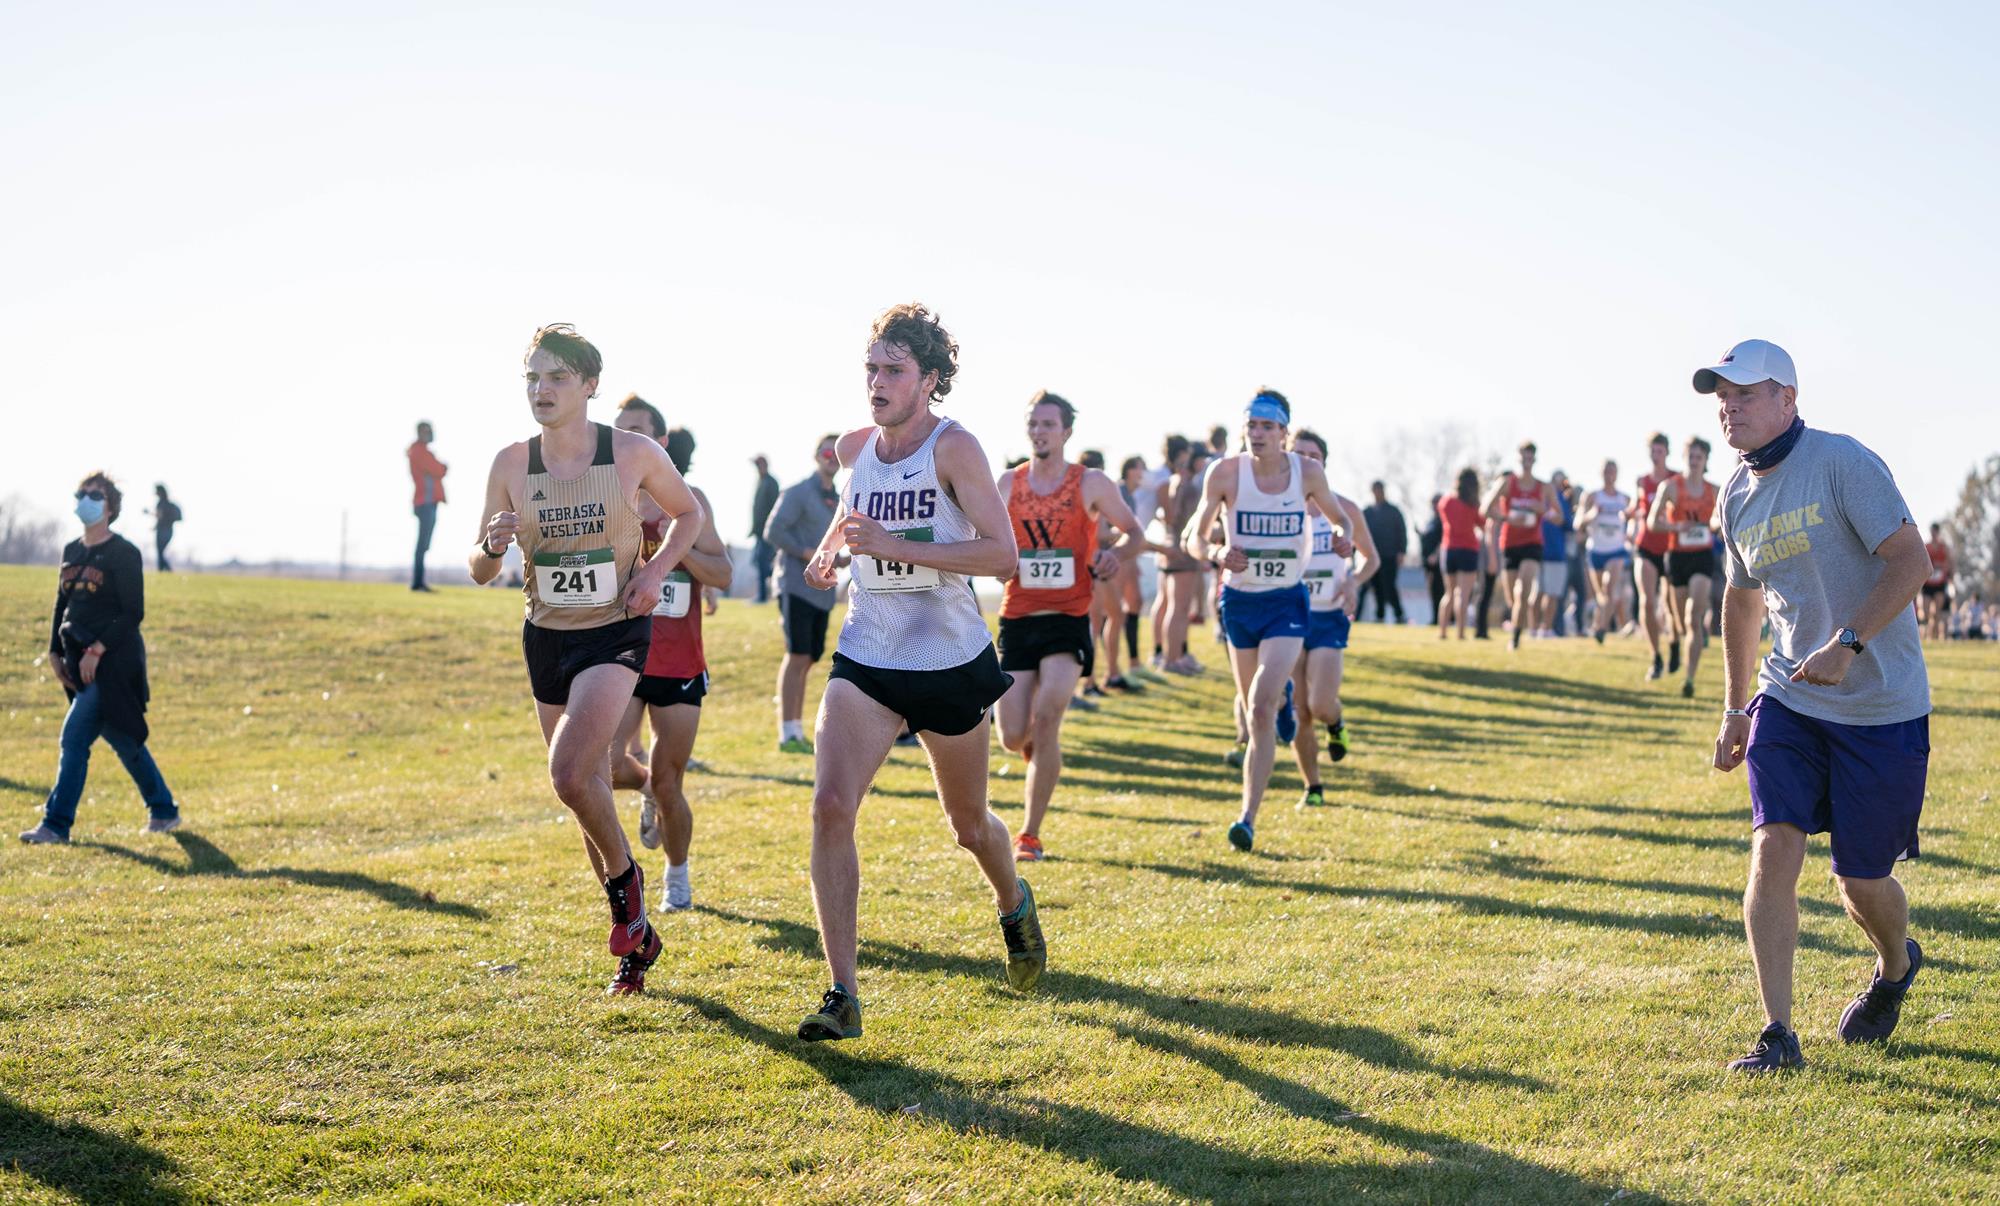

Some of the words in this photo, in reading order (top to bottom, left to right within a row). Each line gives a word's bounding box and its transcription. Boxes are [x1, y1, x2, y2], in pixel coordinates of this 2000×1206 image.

[538, 503, 606, 523] NEBRASKA
[540, 520, 604, 539] WESLEYAN
[1241, 513, 1300, 534] LUTHER
[1030, 562, 1062, 577] 372
[1254, 562, 1285, 577] 192
[551, 569, 597, 593] 241
